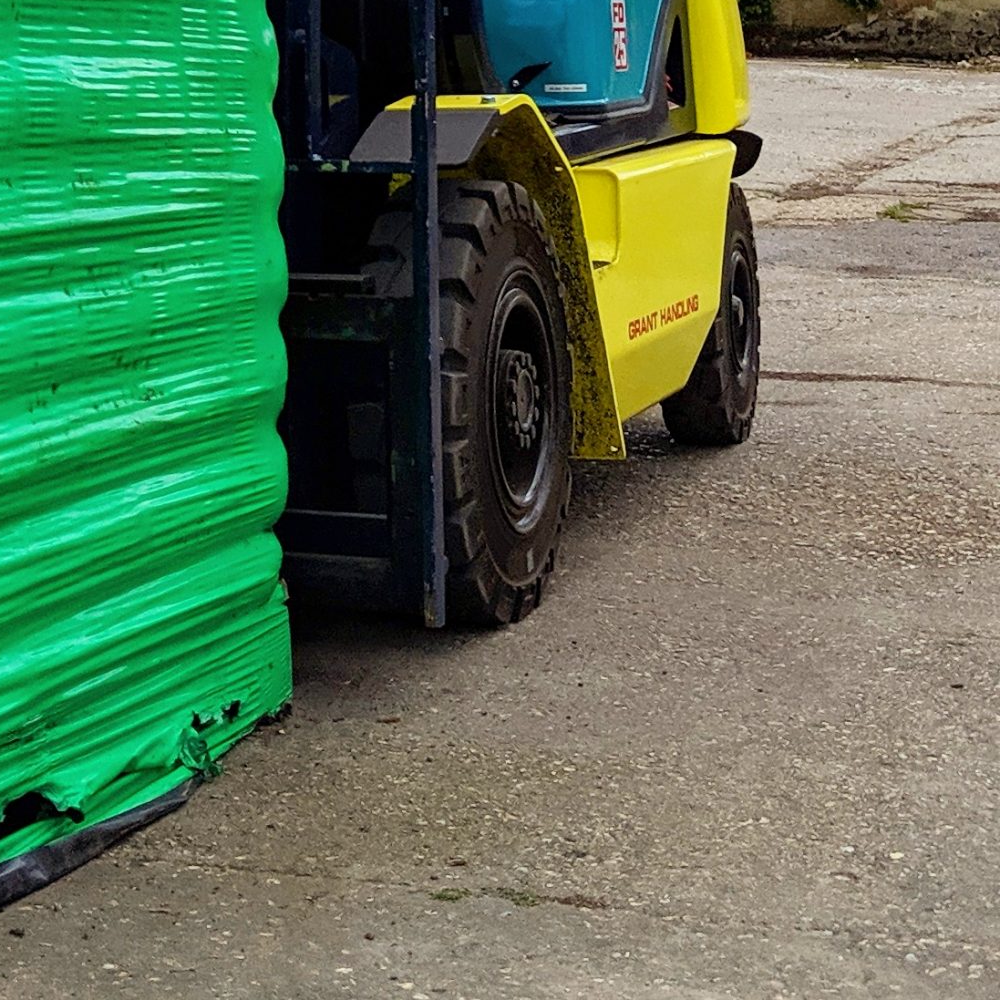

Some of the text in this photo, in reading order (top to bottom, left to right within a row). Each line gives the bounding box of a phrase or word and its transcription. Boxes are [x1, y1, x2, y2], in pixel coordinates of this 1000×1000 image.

[612, 2, 624, 23] FD
[628, 294, 699, 340] GRANT HANDLING
